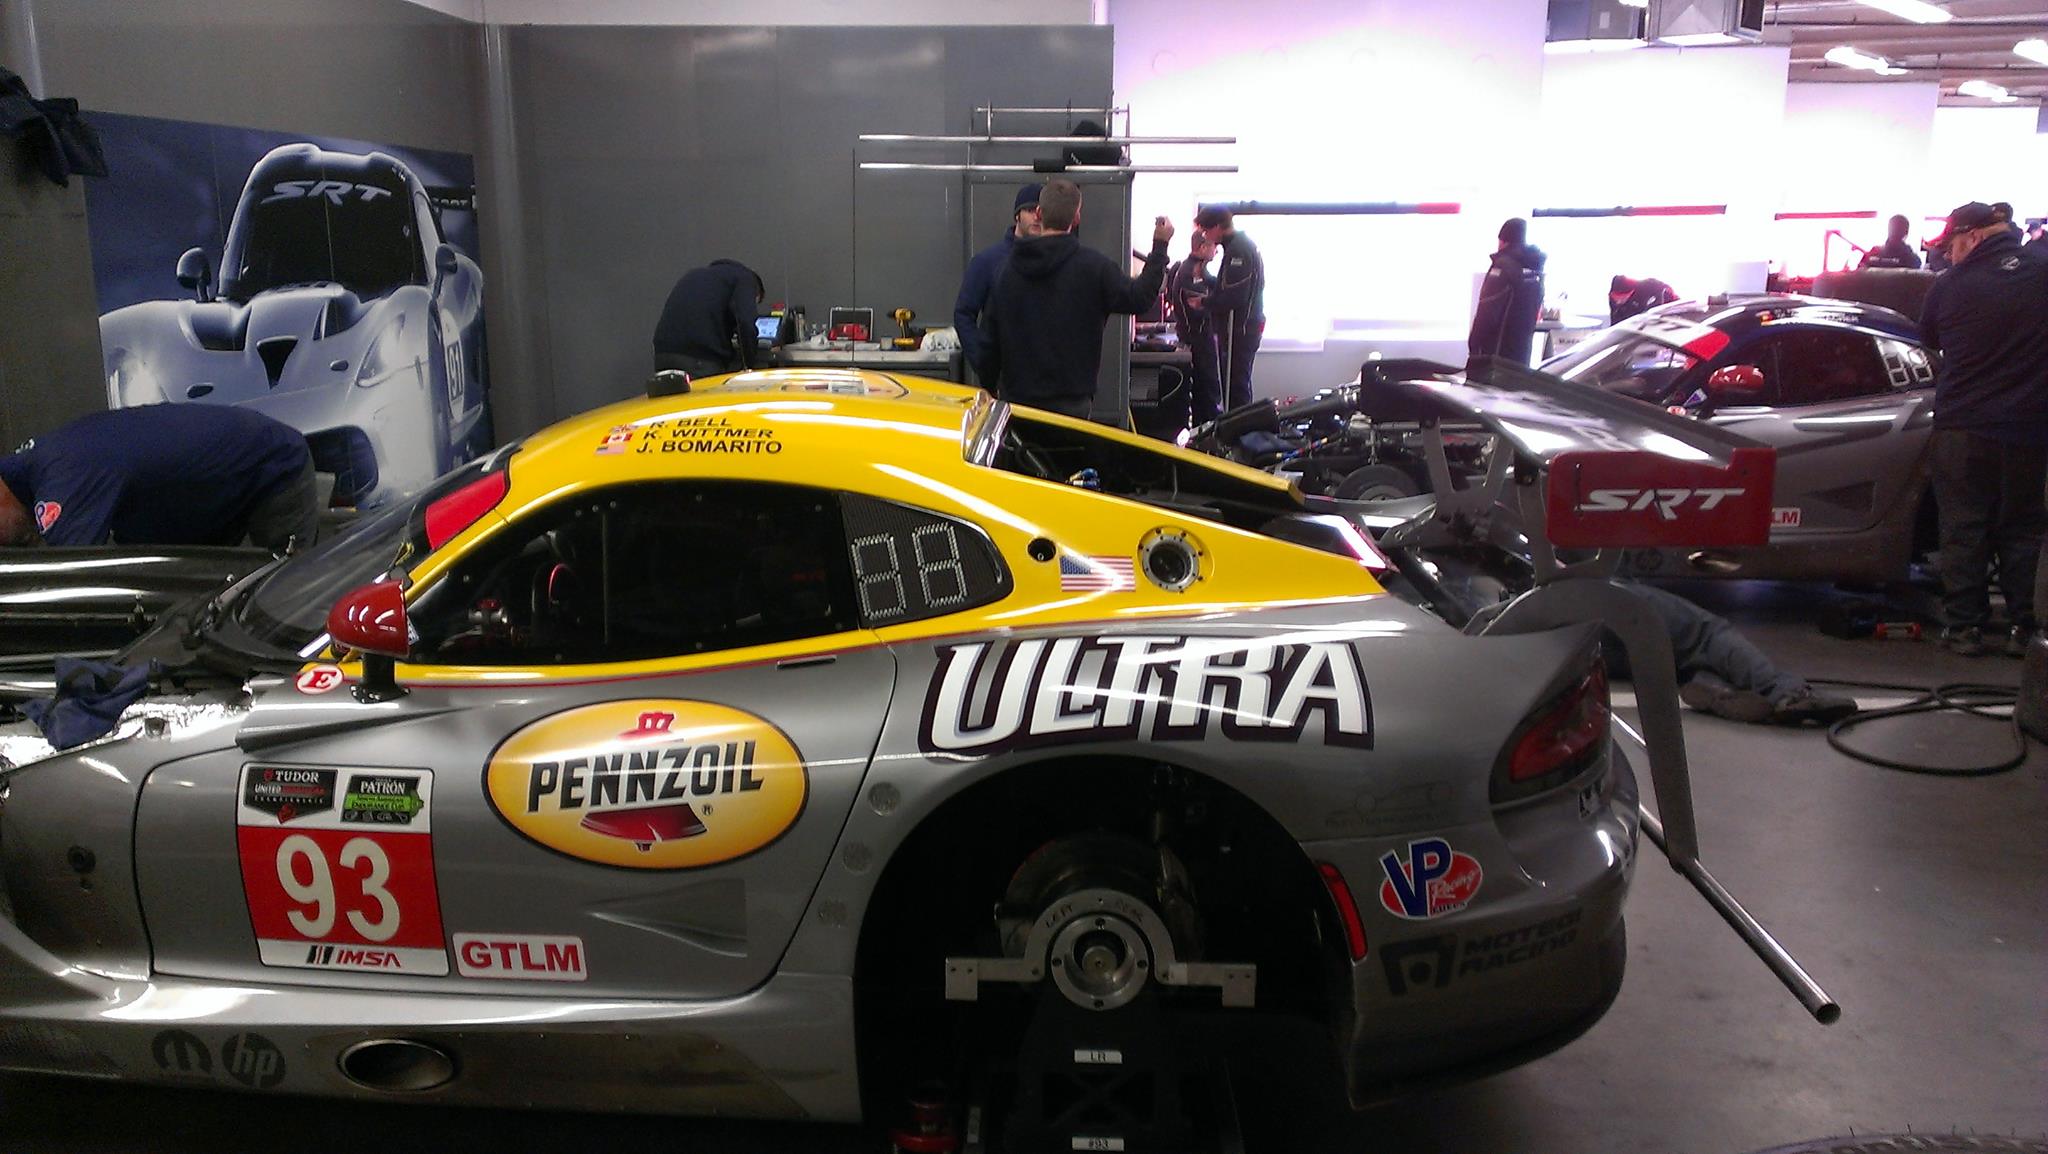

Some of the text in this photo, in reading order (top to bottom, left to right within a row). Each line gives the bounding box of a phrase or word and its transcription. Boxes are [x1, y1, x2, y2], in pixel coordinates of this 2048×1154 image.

[260, 180, 392, 207] SRT
[643, 428, 774, 440] K. WITTMER
[650, 418, 732, 429] R. BELL
[636, 440, 783, 455] J. BOMARITO
[1576, 488, 1746, 520] SRT
[924, 636, 1374, 750] ULTRA
[274, 770, 320, 784] TUDOR
[527, 741, 765, 813] PENNZOIL
[276, 834, 400, 942] 93
[1380, 838, 1453, 918] VP
[335, 949, 402, 969] IMSA
[461, 941, 581, 972] GTLM
